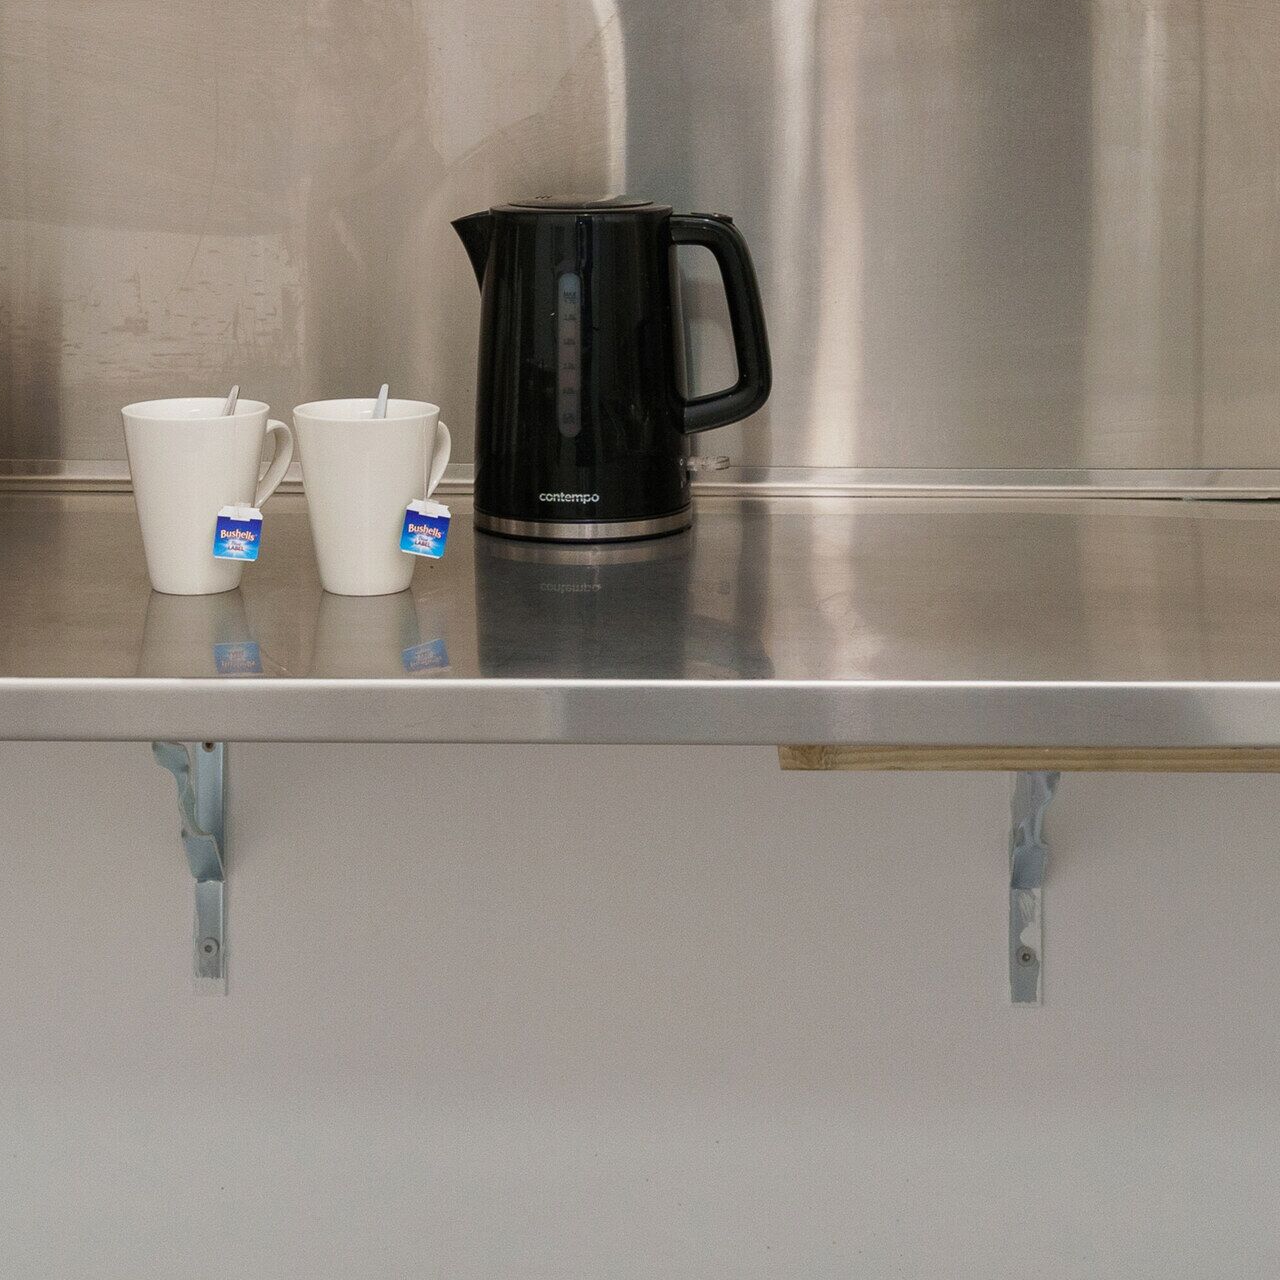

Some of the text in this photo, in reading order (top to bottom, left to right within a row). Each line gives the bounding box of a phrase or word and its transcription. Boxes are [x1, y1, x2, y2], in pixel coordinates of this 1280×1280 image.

[539, 492, 600, 504] contempo
[220, 528, 256, 541] Bushells
[408, 523, 442, 538] Bushells
